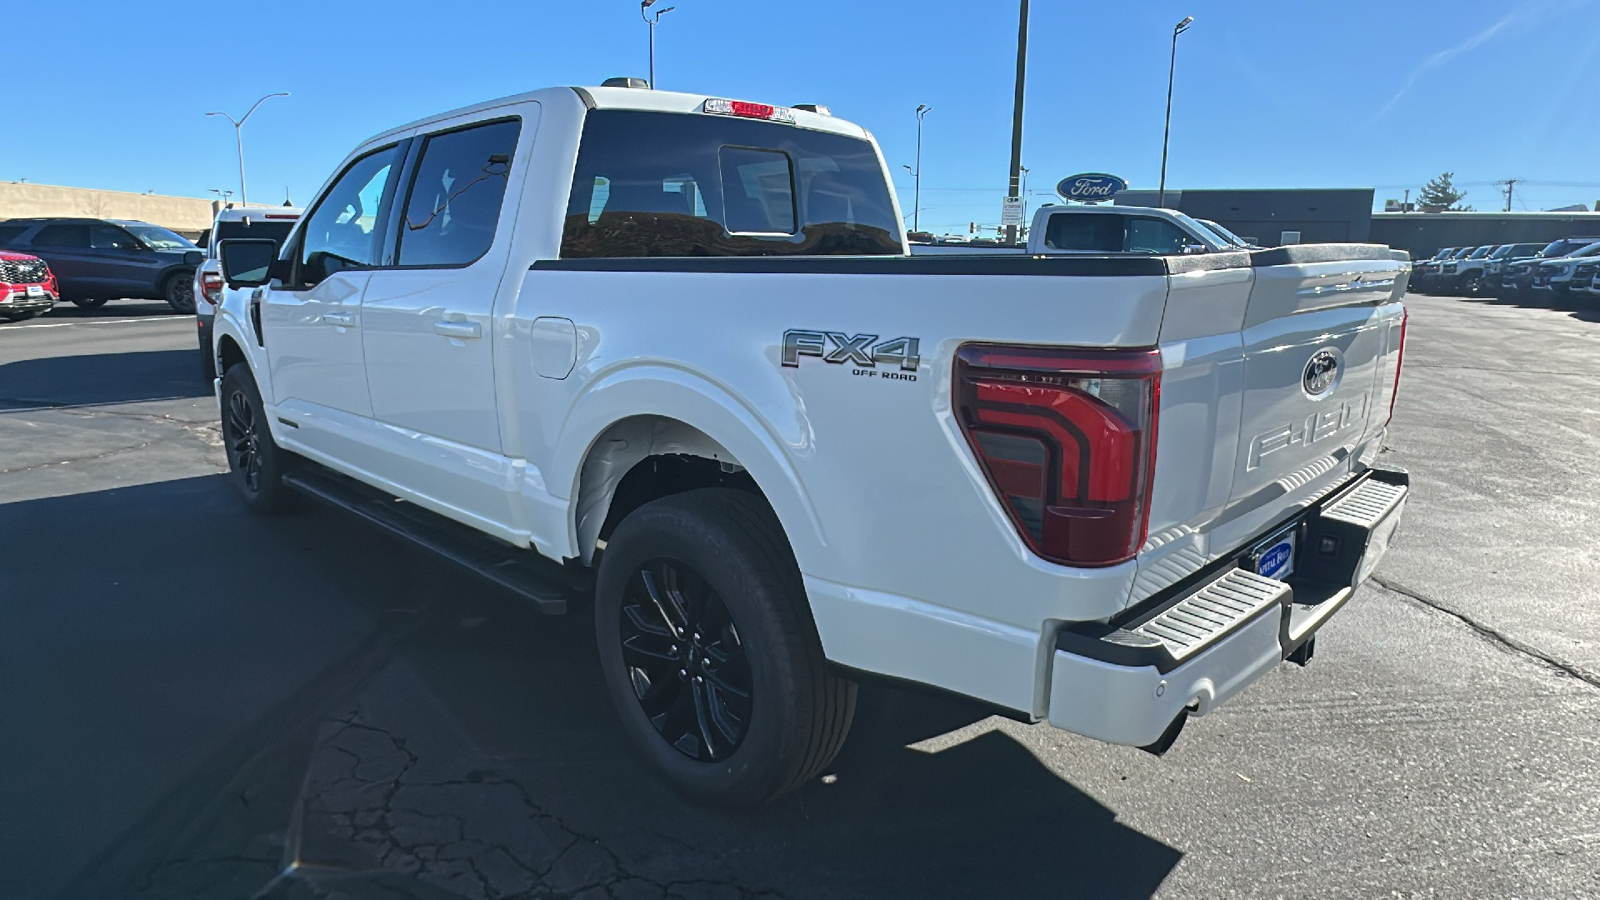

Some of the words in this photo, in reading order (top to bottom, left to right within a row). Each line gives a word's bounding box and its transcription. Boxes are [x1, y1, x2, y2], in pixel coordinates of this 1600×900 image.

[1070, 178, 1113, 196] Ford
[781, 328, 921, 372] FX4
[852, 369, 877, 378] OFF
[882, 371, 917, 382] ROAD
[1310, 358, 1337, 389] Ford
[1246, 392, 1368, 473] F-150
